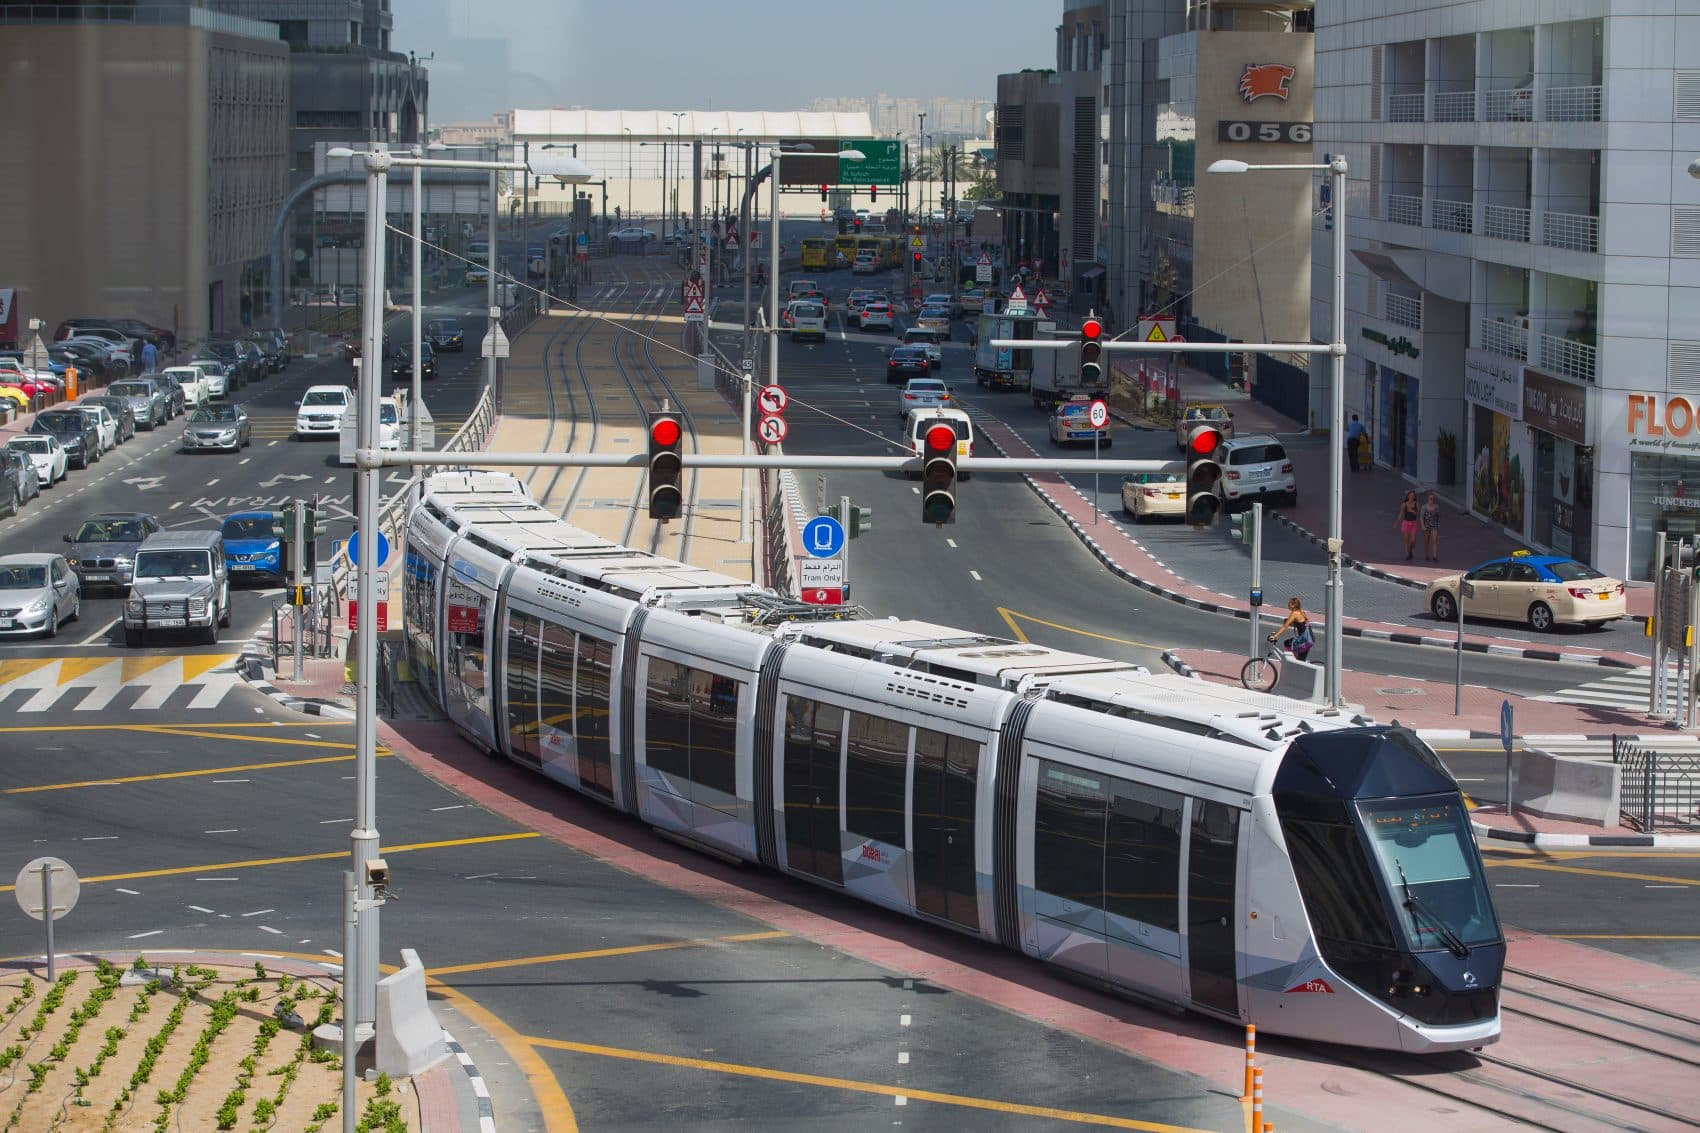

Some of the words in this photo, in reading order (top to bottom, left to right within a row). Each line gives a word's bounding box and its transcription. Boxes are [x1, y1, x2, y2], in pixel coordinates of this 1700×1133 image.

[1228, 123, 1311, 143] 056
[1093, 408, 1104, 420] 60
[1627, 394, 1700, 439] FLO
[823, 564, 841, 572] الترام
[824, 574, 840, 582] Only
[1306, 981, 1327, 993] RTA
